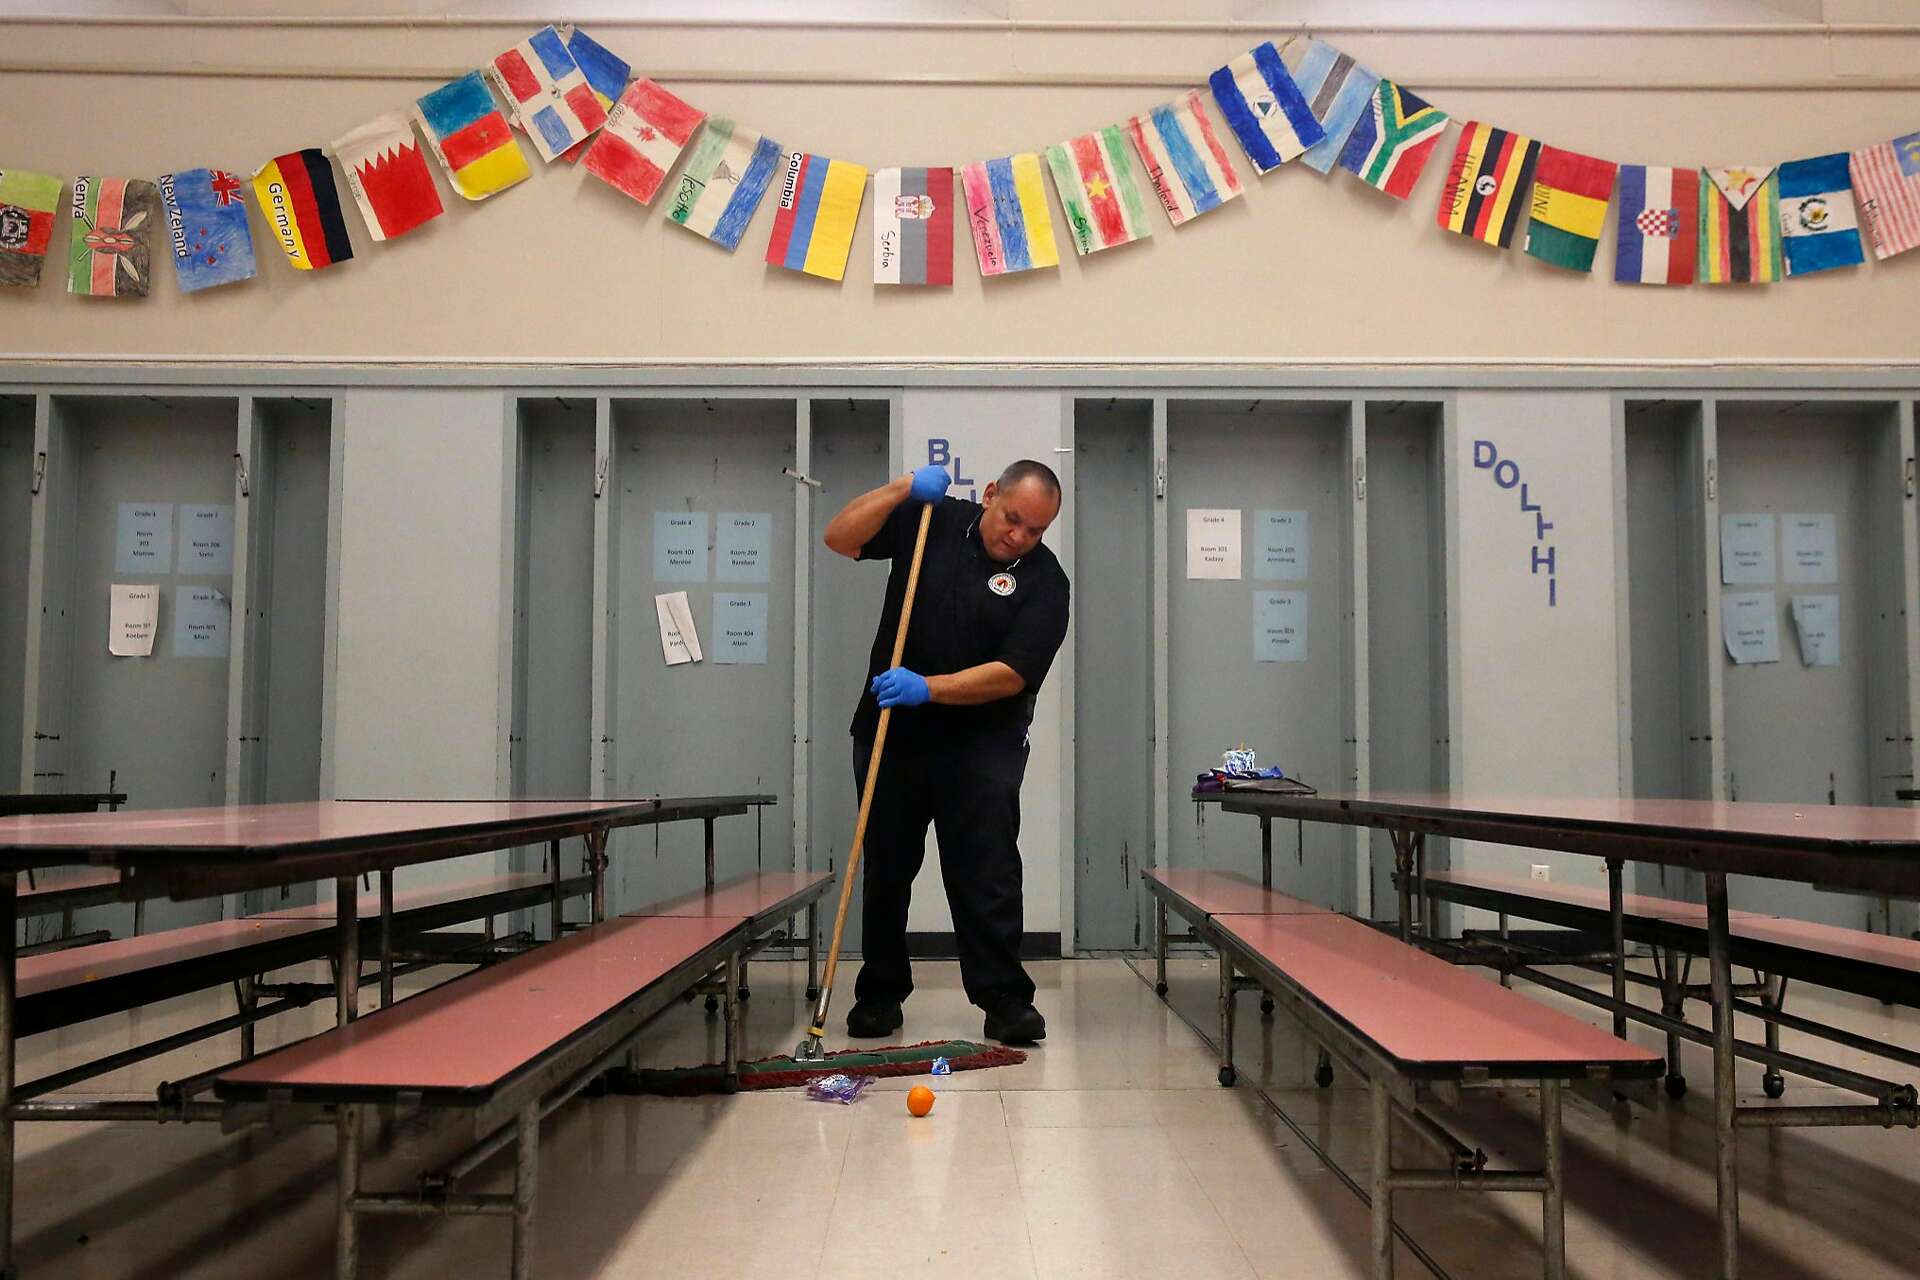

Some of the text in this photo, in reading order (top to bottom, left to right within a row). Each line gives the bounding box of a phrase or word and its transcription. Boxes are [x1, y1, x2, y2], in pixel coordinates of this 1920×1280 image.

[73, 176, 91, 219] Kenya
[780, 152, 803, 208] Columbia
[160, 174, 191, 258] New Zeland
[269, 183, 300, 258] Germany
[881, 230, 896, 269] Serbia
